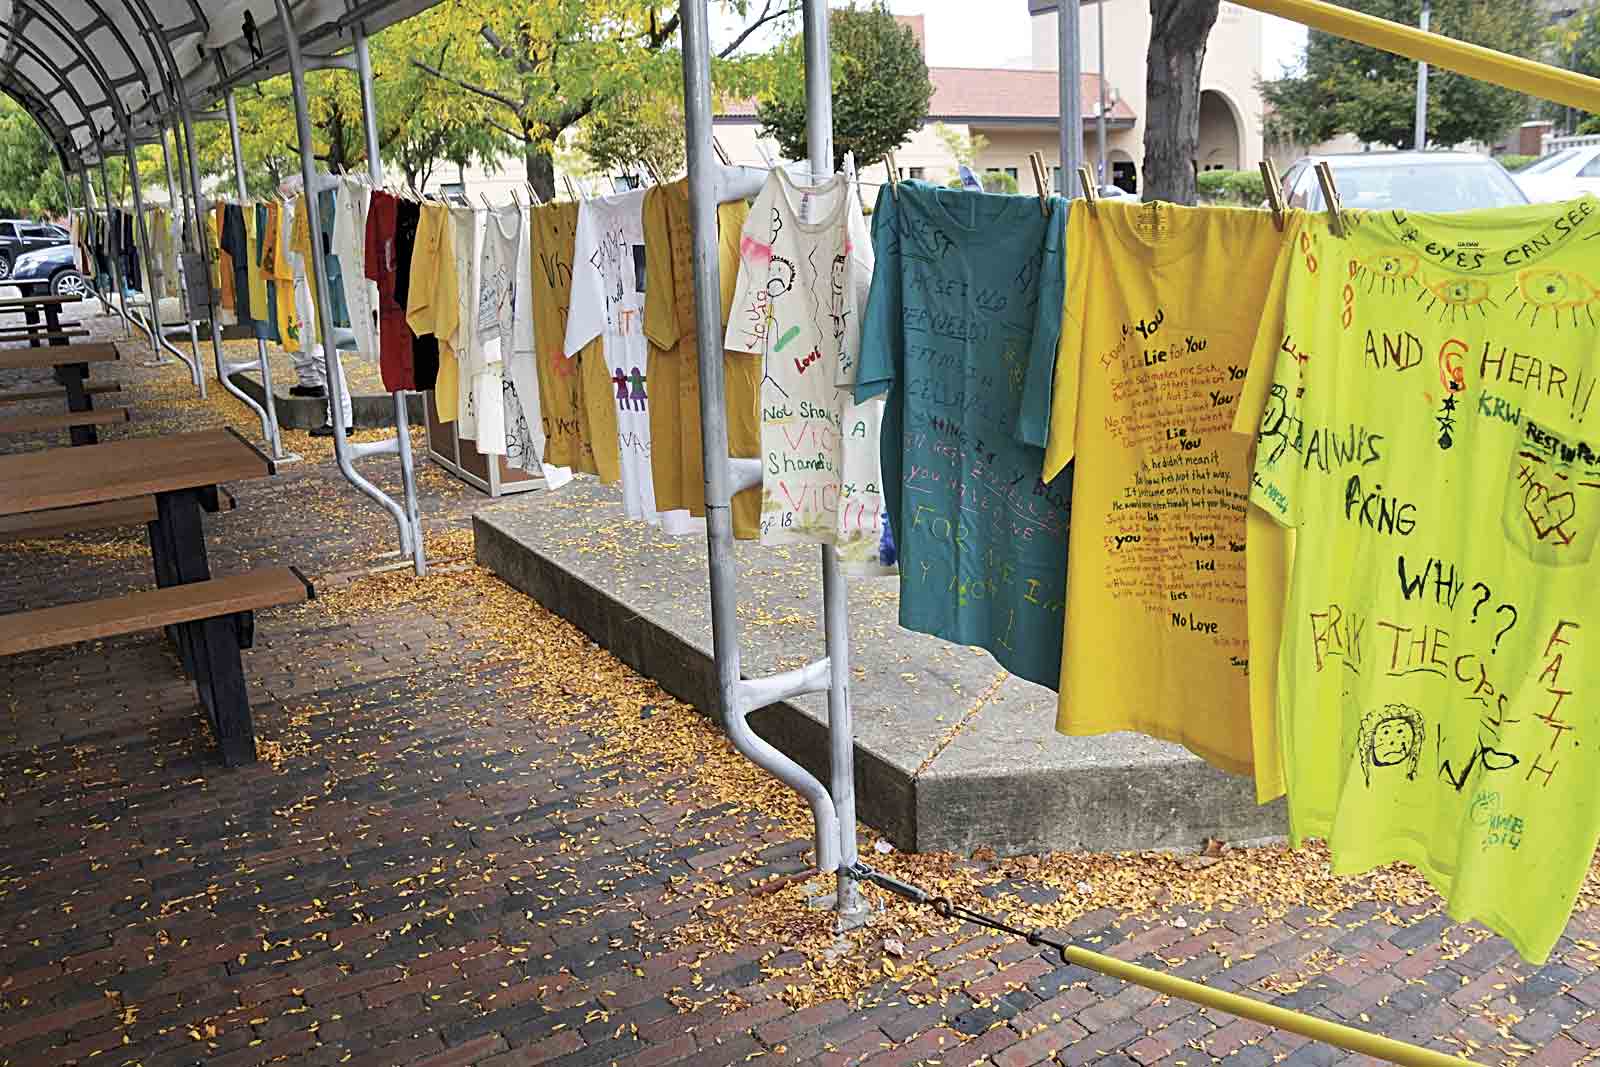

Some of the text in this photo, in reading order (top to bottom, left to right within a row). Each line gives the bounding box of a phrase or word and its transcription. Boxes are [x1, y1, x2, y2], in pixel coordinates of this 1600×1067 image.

[1503, 236, 1552, 266] CAN
[1553, 201, 1594, 238] SEE
[1135, 309, 1165, 340] You
[1143, 350, 1168, 367] Lie
[1185, 336, 1207, 353] You
[1364, 329, 1424, 372] AND
[1209, 390, 1234, 408] You
[1477, 389, 1522, 426] KRW
[762, 404, 793, 422] Not
[1166, 428, 1187, 441] Lie
[1180, 438, 1201, 451] You
[1525, 421, 1561, 455] REST
[780, 511, 793, 528] 18
[1114, 535, 1141, 550] you
[1189, 531, 1215, 547] lying
[1196, 559, 1216, 571] lied
[1170, 590, 1188, 601] lies
[1171, 611, 1218, 634] No Love
[1377, 620, 1450, 670] THE
[1525, 620, 1582, 788] FAITH
